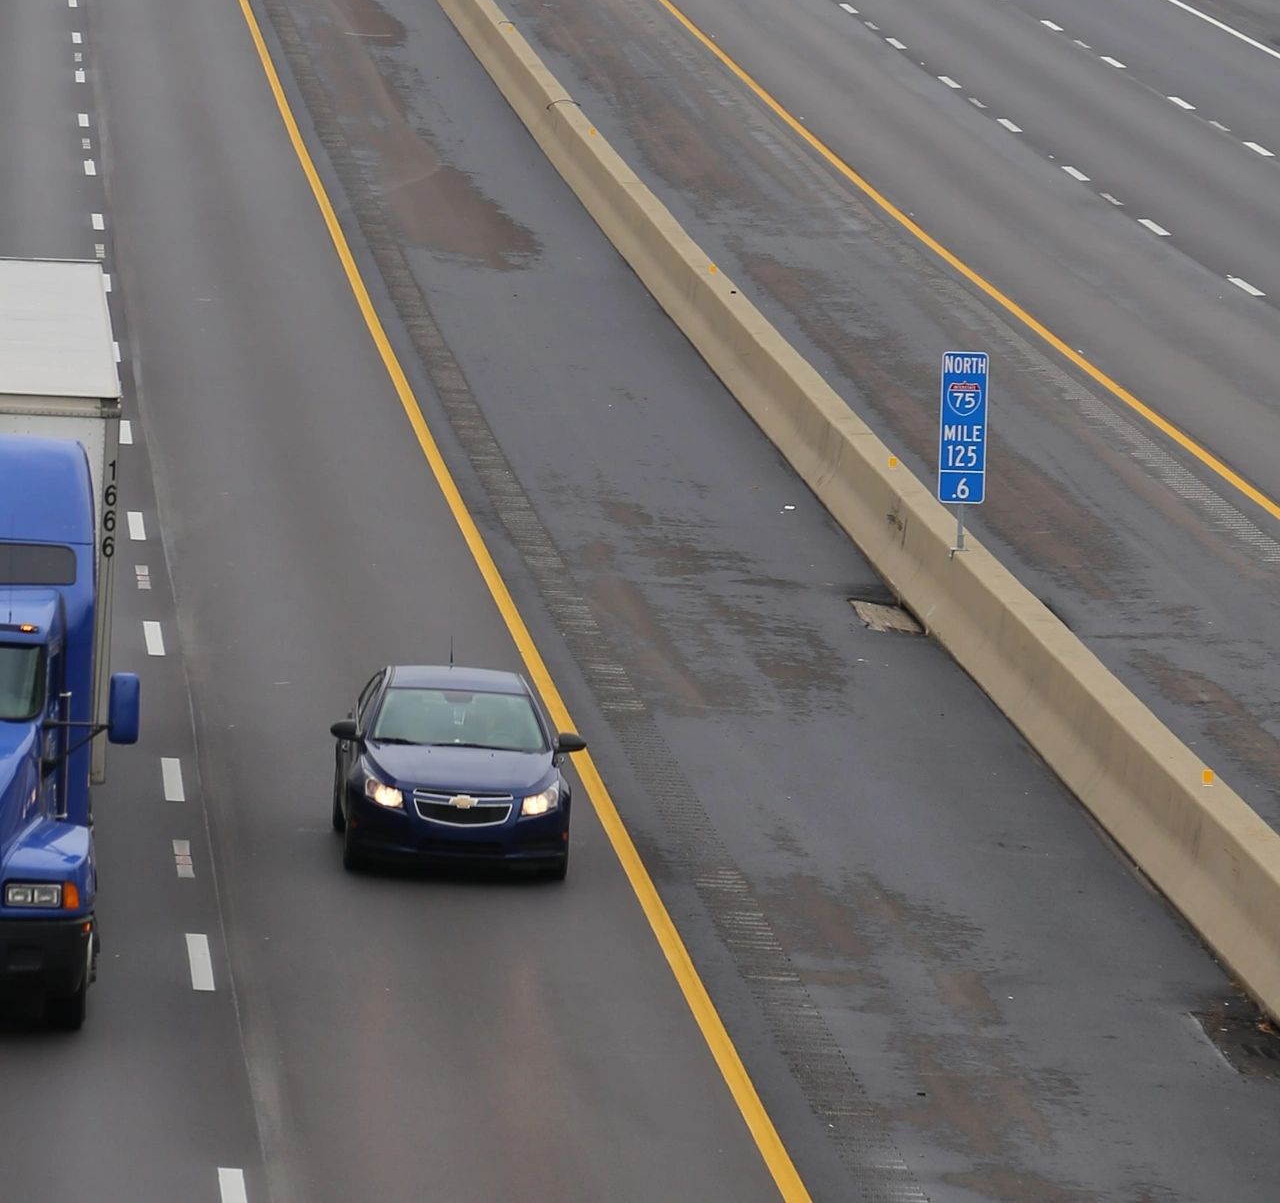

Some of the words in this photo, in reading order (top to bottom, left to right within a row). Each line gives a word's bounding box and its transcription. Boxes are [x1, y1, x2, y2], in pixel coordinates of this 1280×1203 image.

[944, 355, 986, 374] NORTH
[953, 393, 976, 409] 75
[944, 424, 982, 442] MILE
[947, 445, 977, 467] 125
[951, 477, 970, 499] .6
[102, 459, 118, 558] 1666
